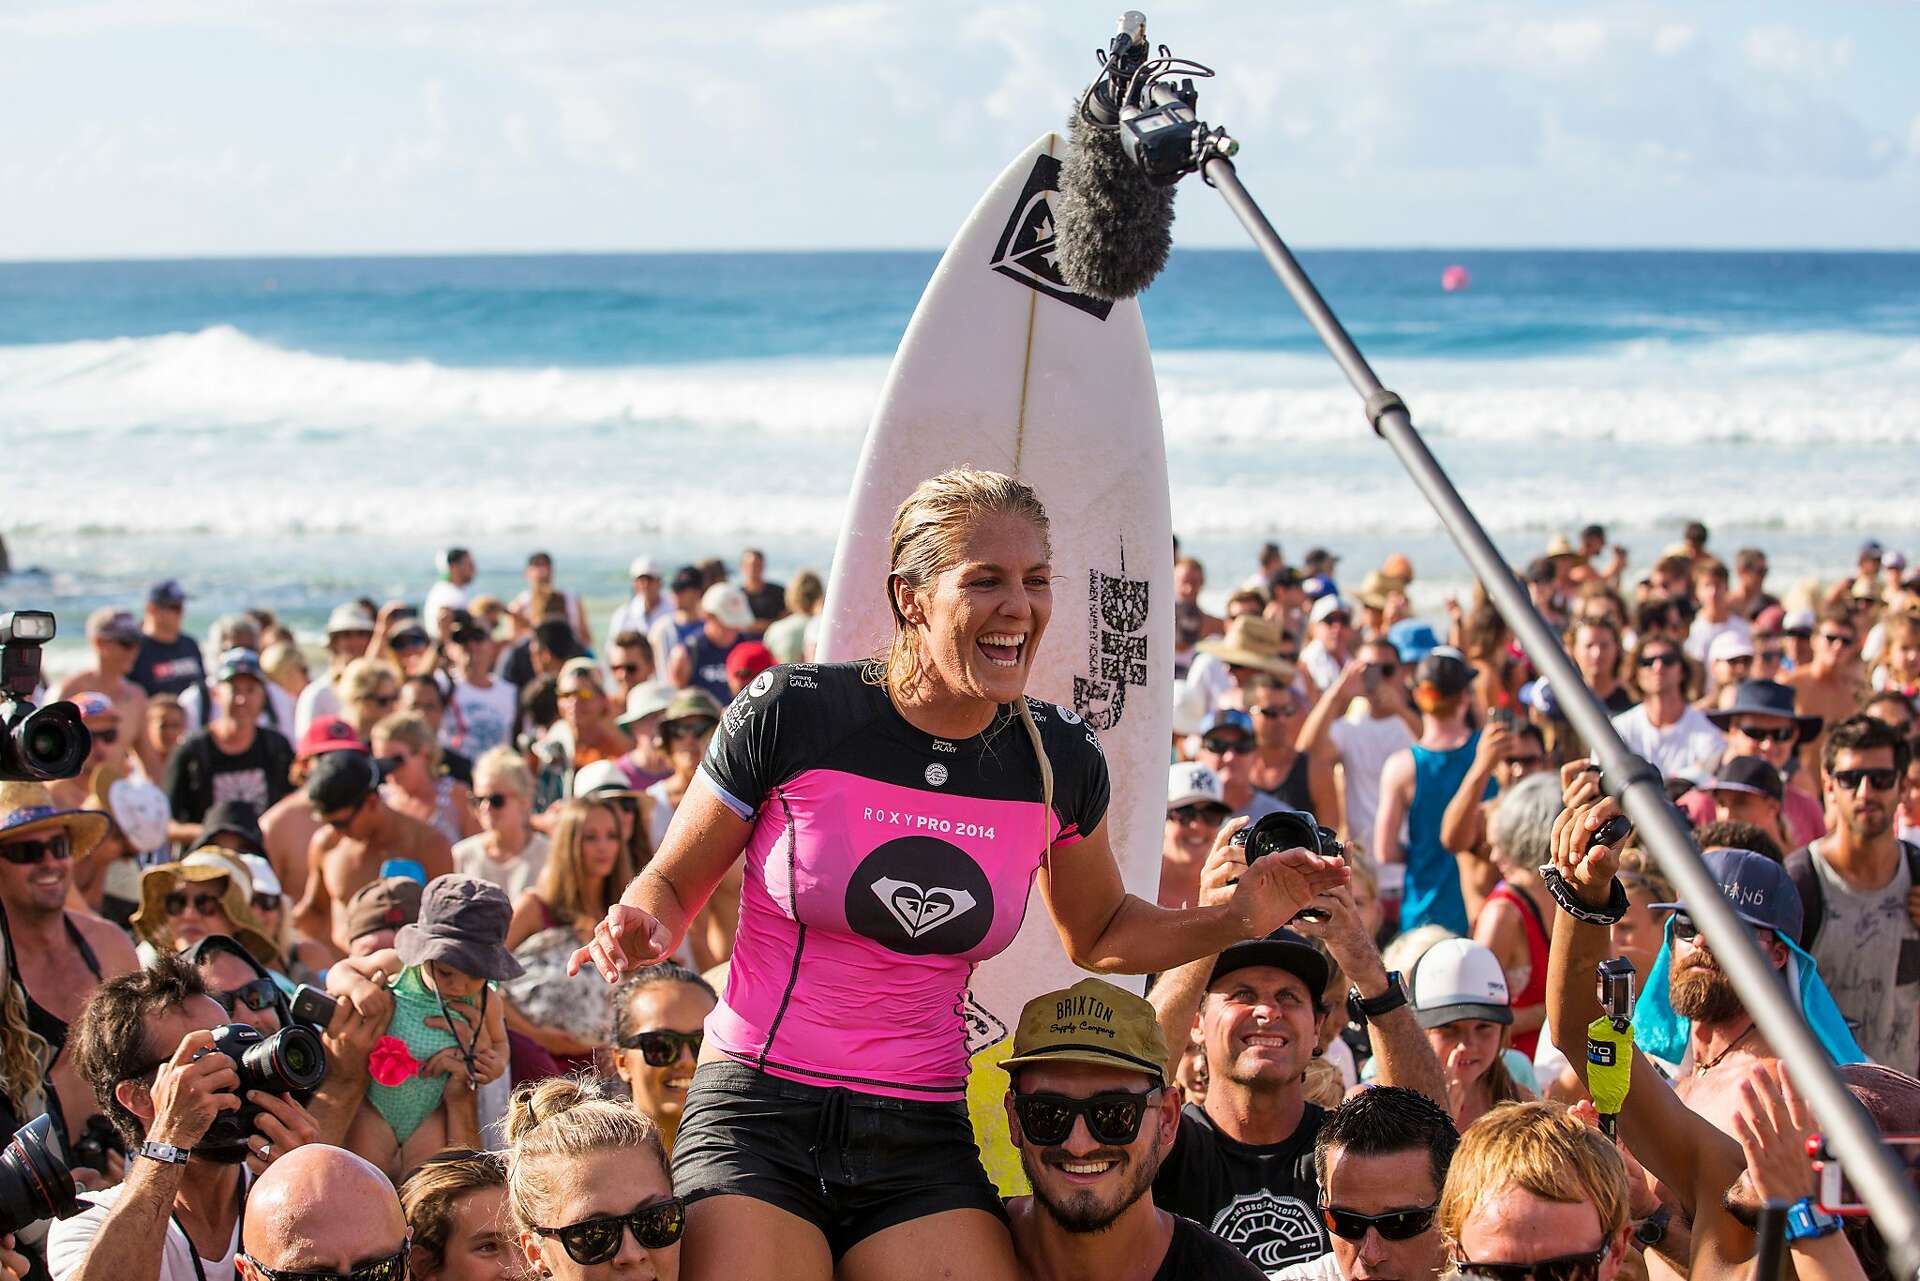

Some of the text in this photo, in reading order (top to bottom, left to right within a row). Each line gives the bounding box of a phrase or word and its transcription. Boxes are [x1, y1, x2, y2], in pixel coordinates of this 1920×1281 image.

[789, 680, 819, 689] GALAXY
[932, 743, 958, 753] GALAXY
[863, 807, 996, 840] ROXY PRO 2014
[1717, 882, 1765, 906] TAND
[1056, 995, 1114, 1023] BRIXTON
[1049, 1020, 1115, 1039] Supply Company
